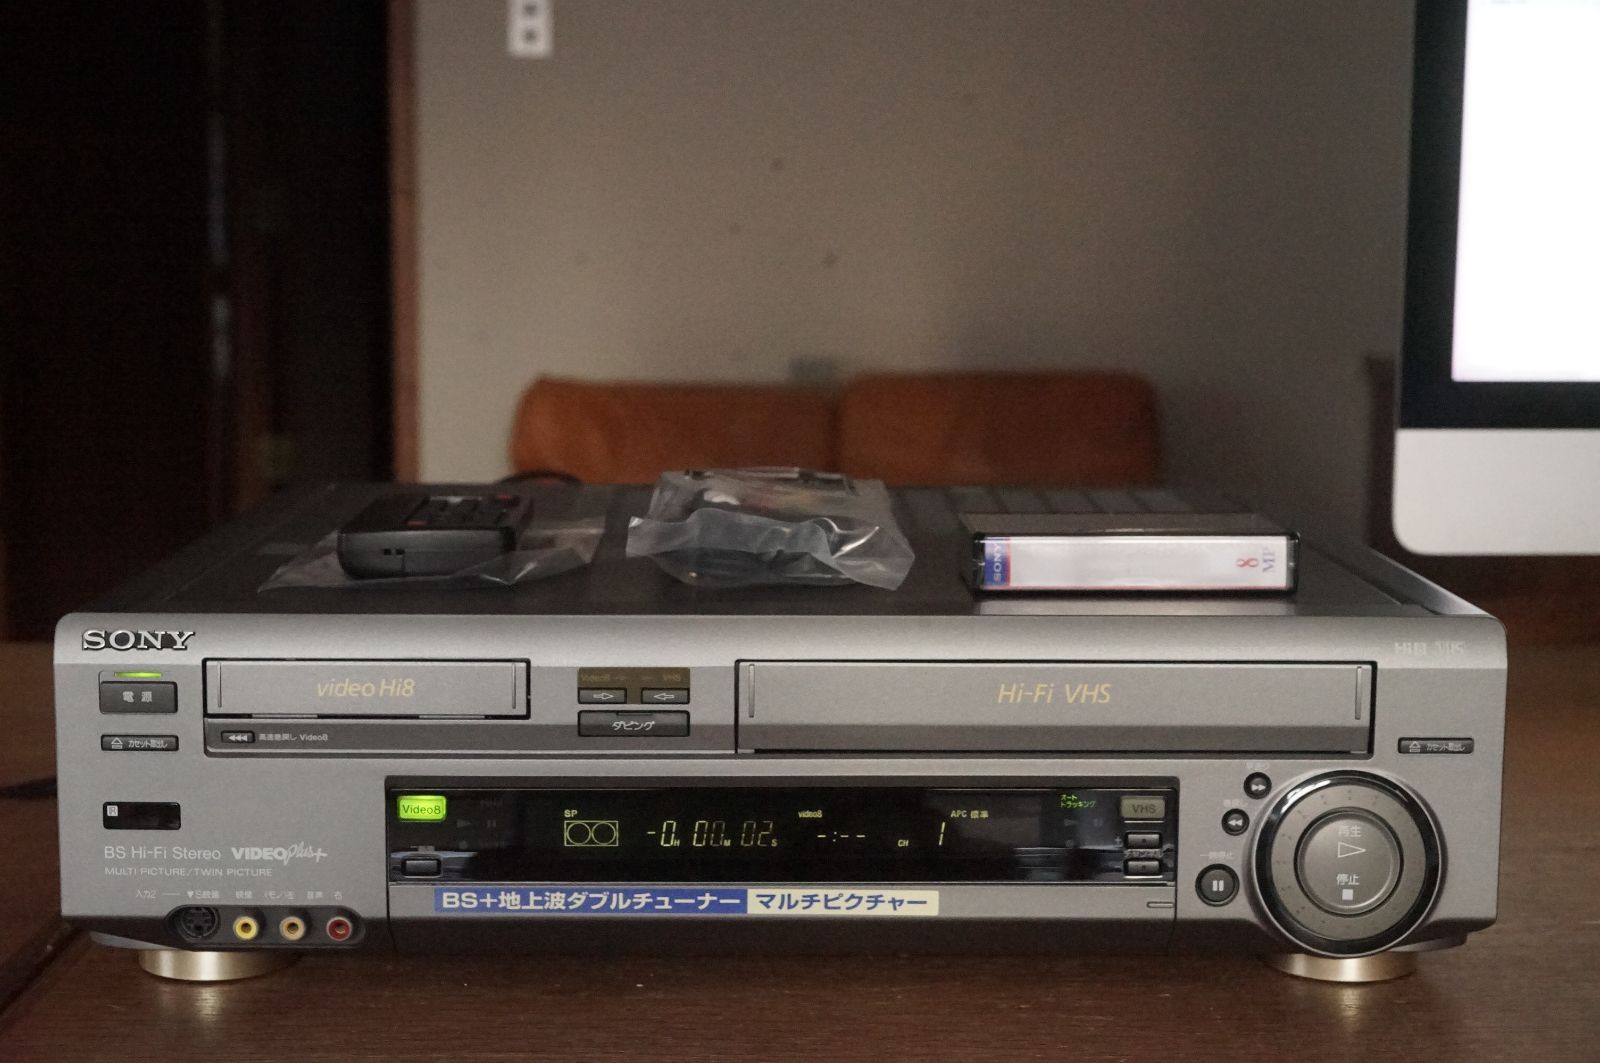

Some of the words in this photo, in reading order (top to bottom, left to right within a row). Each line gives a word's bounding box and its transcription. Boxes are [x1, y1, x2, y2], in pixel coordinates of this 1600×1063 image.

[1236, 558, 1259, 568] 8
[82, 630, 195, 650] SONY
[317, 678, 376, 697] video
[379, 678, 416, 697] Hi8
[997, 683, 1055, 704] Hi-Fi
[1064, 683, 1112, 704] VHS
[612, 721, 656, 731] ダビング
[402, 804, 441, 815] Video8
[564, 809, 578, 818] SP
[950, 810, 968, 818] APC
[1131, 804, 1156, 814] VHS
[104, 846, 126, 860] BS
[131, 845, 167, 860] Hi-Fi
[172, 846, 222, 860] Stereo
[104, 867, 137, 876] MULTI
[226, 868, 273, 877] PICTURE
[1336, 873, 1360, 886] 停止
[755, 893, 928, 911] マルチピクチャー
